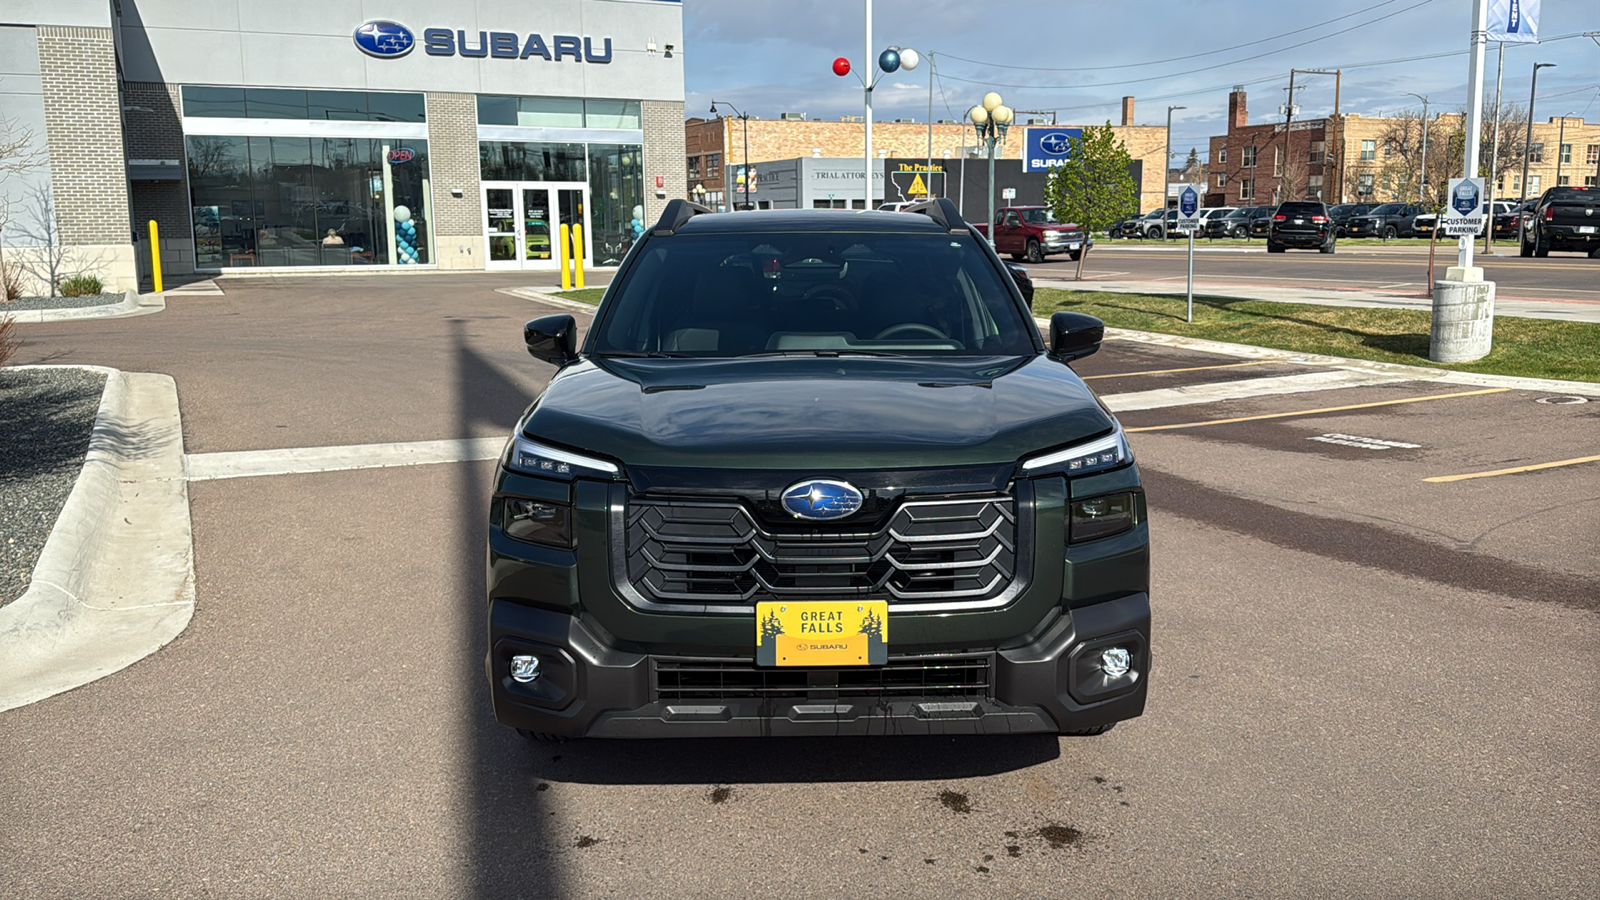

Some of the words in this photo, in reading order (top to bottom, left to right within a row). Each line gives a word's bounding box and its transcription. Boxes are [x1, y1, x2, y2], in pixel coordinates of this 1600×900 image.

[423, 27, 612, 64] SUBARU
[388, 150, 413, 160] OPEN
[898, 163, 913, 172] The
[815, 172, 840, 180] TRIAL
[841, 172, 884, 180] ATTOREYS
[801, 611, 843, 621] GREAT
[801, 622, 843, 633] FALLS
